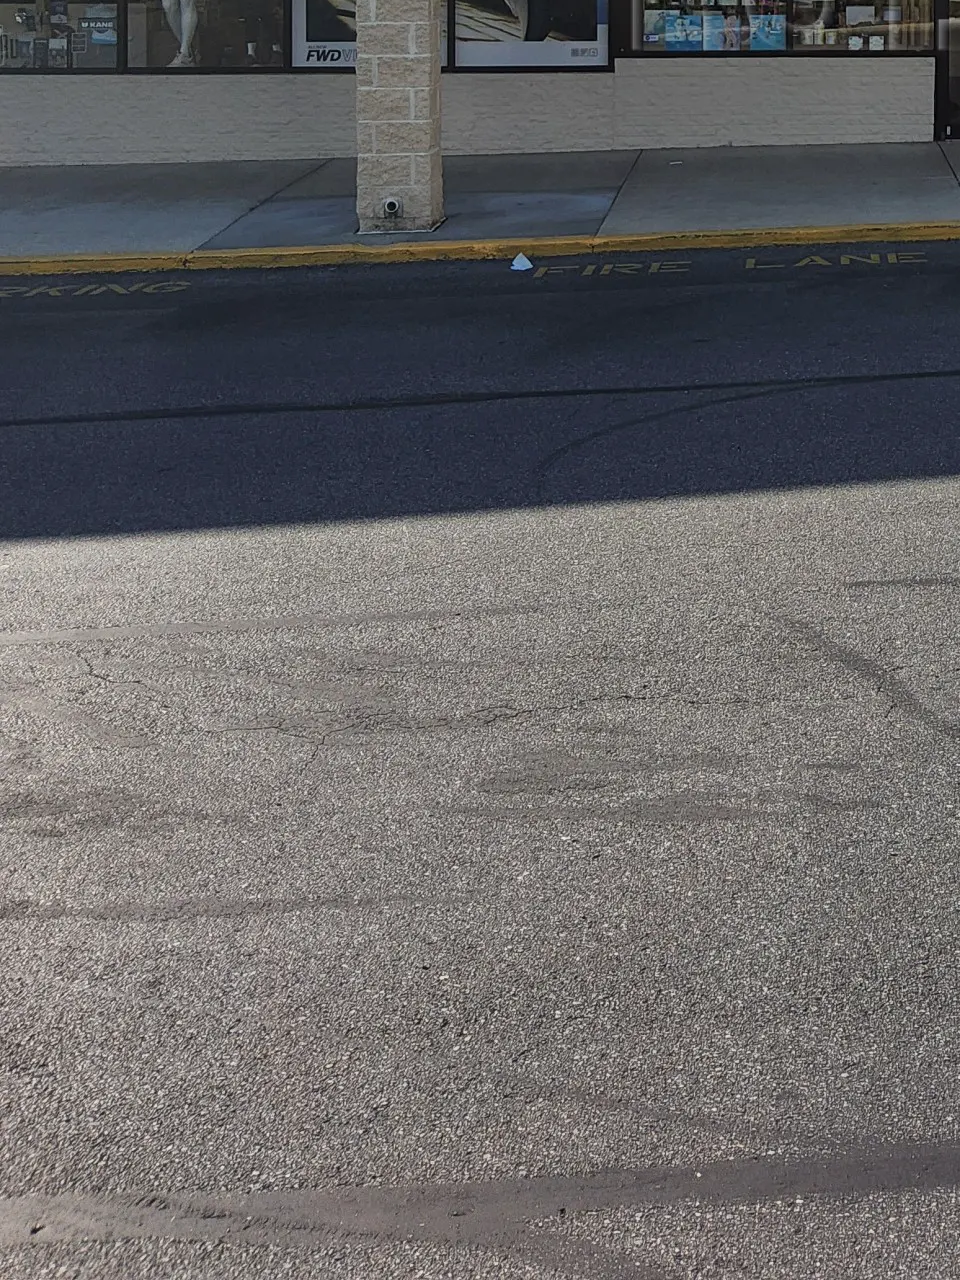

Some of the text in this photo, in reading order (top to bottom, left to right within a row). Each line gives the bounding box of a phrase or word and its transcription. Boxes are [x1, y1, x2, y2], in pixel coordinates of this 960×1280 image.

[306, 49, 342, 62] FWD
[532, 251, 929, 279] FIRE LANE
